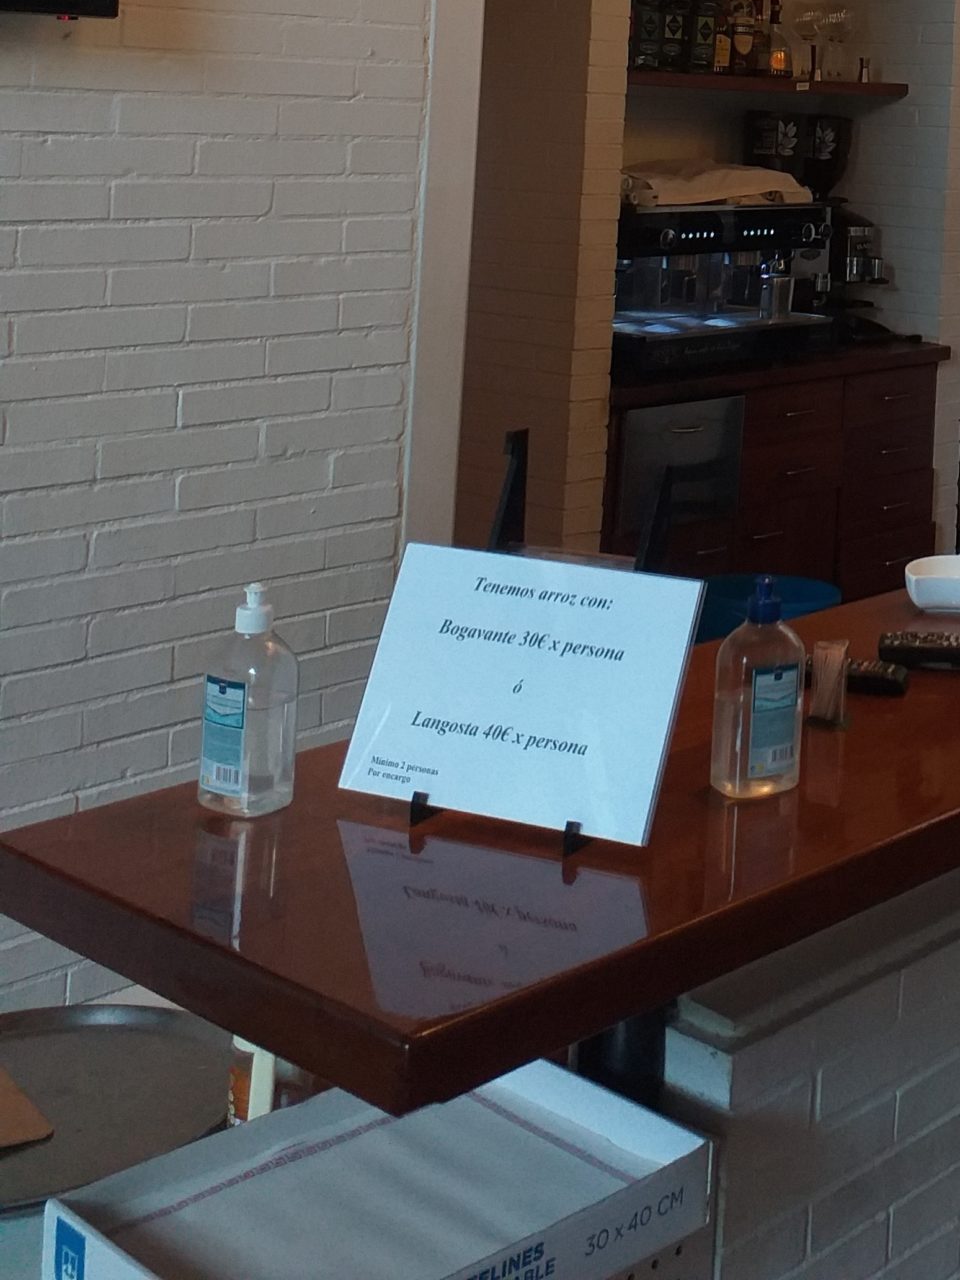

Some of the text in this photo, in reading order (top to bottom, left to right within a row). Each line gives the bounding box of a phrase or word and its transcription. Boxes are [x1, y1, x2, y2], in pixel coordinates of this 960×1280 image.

[473, 576, 614, 610] Tenemos arroz con:
[438, 618, 625, 662] Bogavante 30€ x persona
[512, 678, 524, 695] ó
[410, 710, 589, 756] Langosta 40€ x persona
[368, 768, 411, 784] Por encargo
[400, 761, 406, 770] 2
[406, 763, 438, 776] personas
[584, 1229, 610, 1256] 30
[626, 1206, 652, 1233] 40
[657, 1186, 684, 1216] CM
